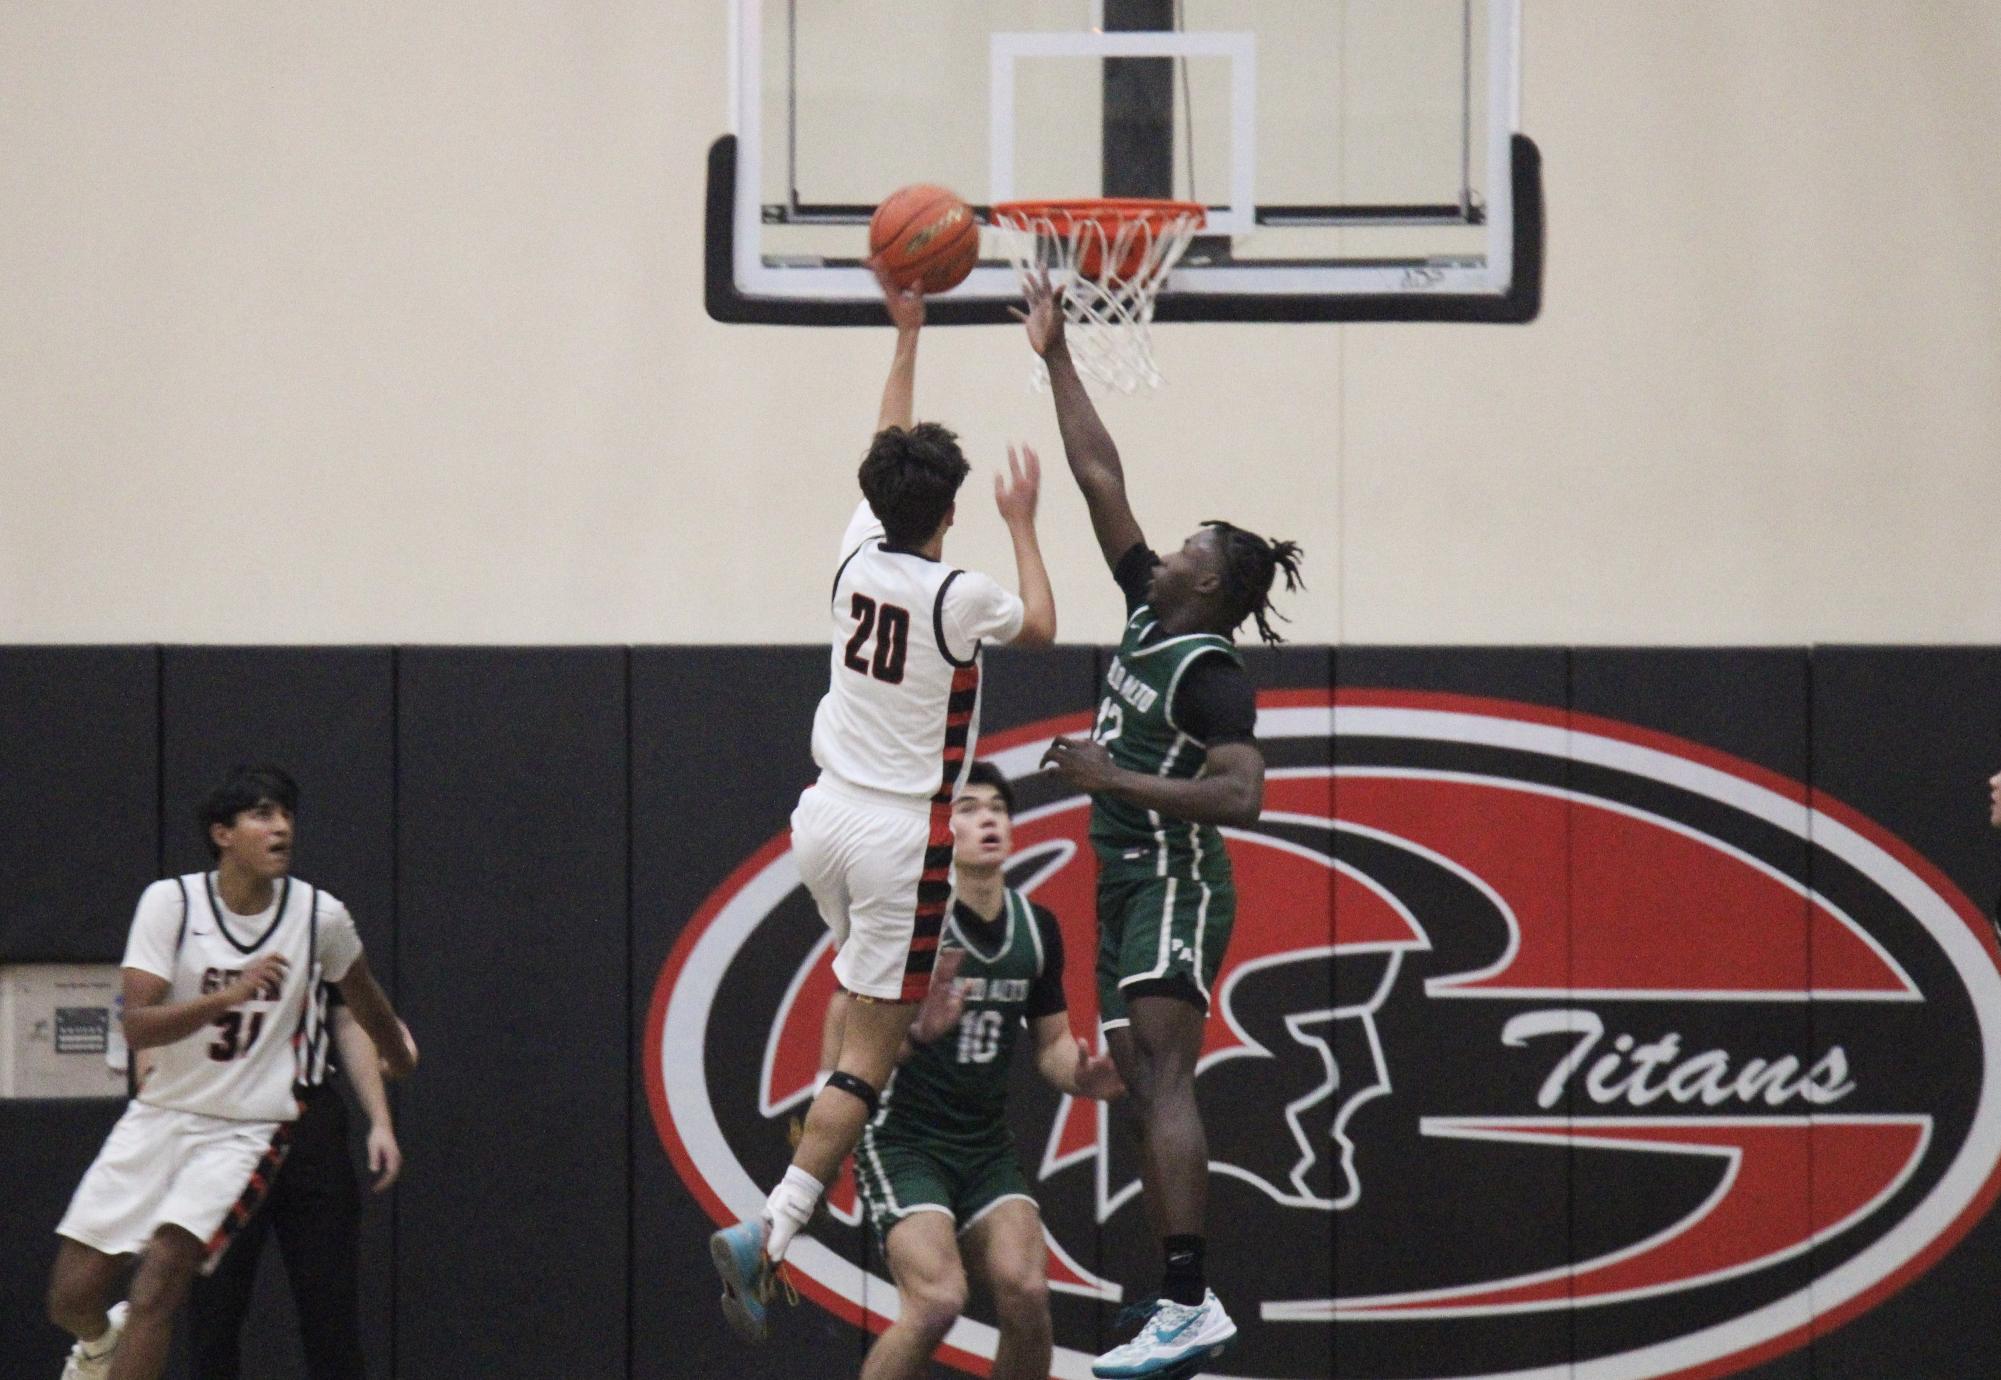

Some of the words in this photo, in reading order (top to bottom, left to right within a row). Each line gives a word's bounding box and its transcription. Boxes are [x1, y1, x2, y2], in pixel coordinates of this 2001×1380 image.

[844, 592, 910, 685] 20
[1120, 674, 1159, 713] ALTO
[1093, 696, 1124, 746] 12
[957, 1010, 1004, 1064] 10
[1500, 1009, 1857, 1109] Titans
